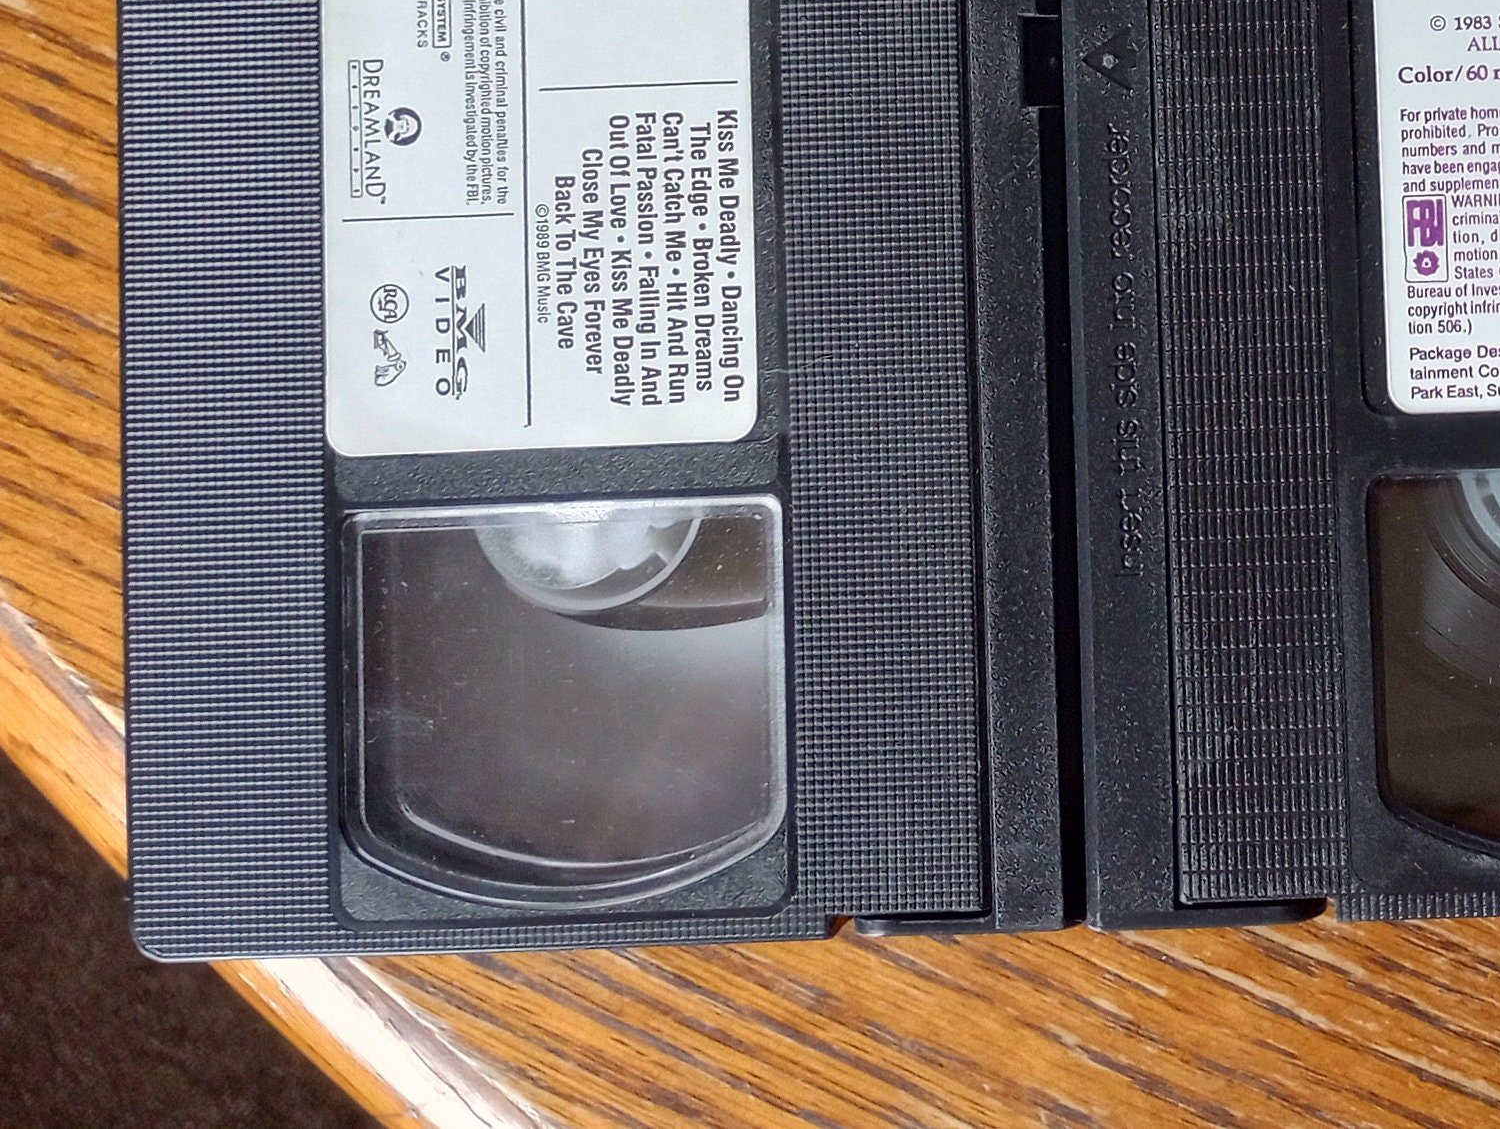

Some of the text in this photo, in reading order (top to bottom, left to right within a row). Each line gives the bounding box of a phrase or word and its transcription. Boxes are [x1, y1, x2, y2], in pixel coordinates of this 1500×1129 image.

[1453, 15, 1493, 31] 1983
[1400, 123, 1472, 142] prohibited.
[536, 251, 551, 283] BMG
[554, 175, 578, 350] Back To The Cave
[579, 148, 606, 375] Close My Eyes Forever
[608, 115, 636, 407] Out Of Love Kiss Me Deadly
[635, 112, 663, 406] Fatal Passion Falling In And
[661, 112, 690, 404] Can't Catch Me Hit And Run
[689, 121, 716, 392] The Edge Broken Dreams
[717, 109, 745, 402] Kiss Me Deadly Dancing On
[1406, 198, 1445, 248] FBI
[380, 287, 398, 320] RCA
[452, 265, 470, 401] BMG
[536, 285, 552, 324] Music
[1104, 124, 1144, 577] Insert this side into recorder
[1409, 346, 1472, 362] Package
[1409, 365, 1474, 381] tainment
[1410, 385, 1444, 400] Park
[1446, 384, 1483, 399] East,
